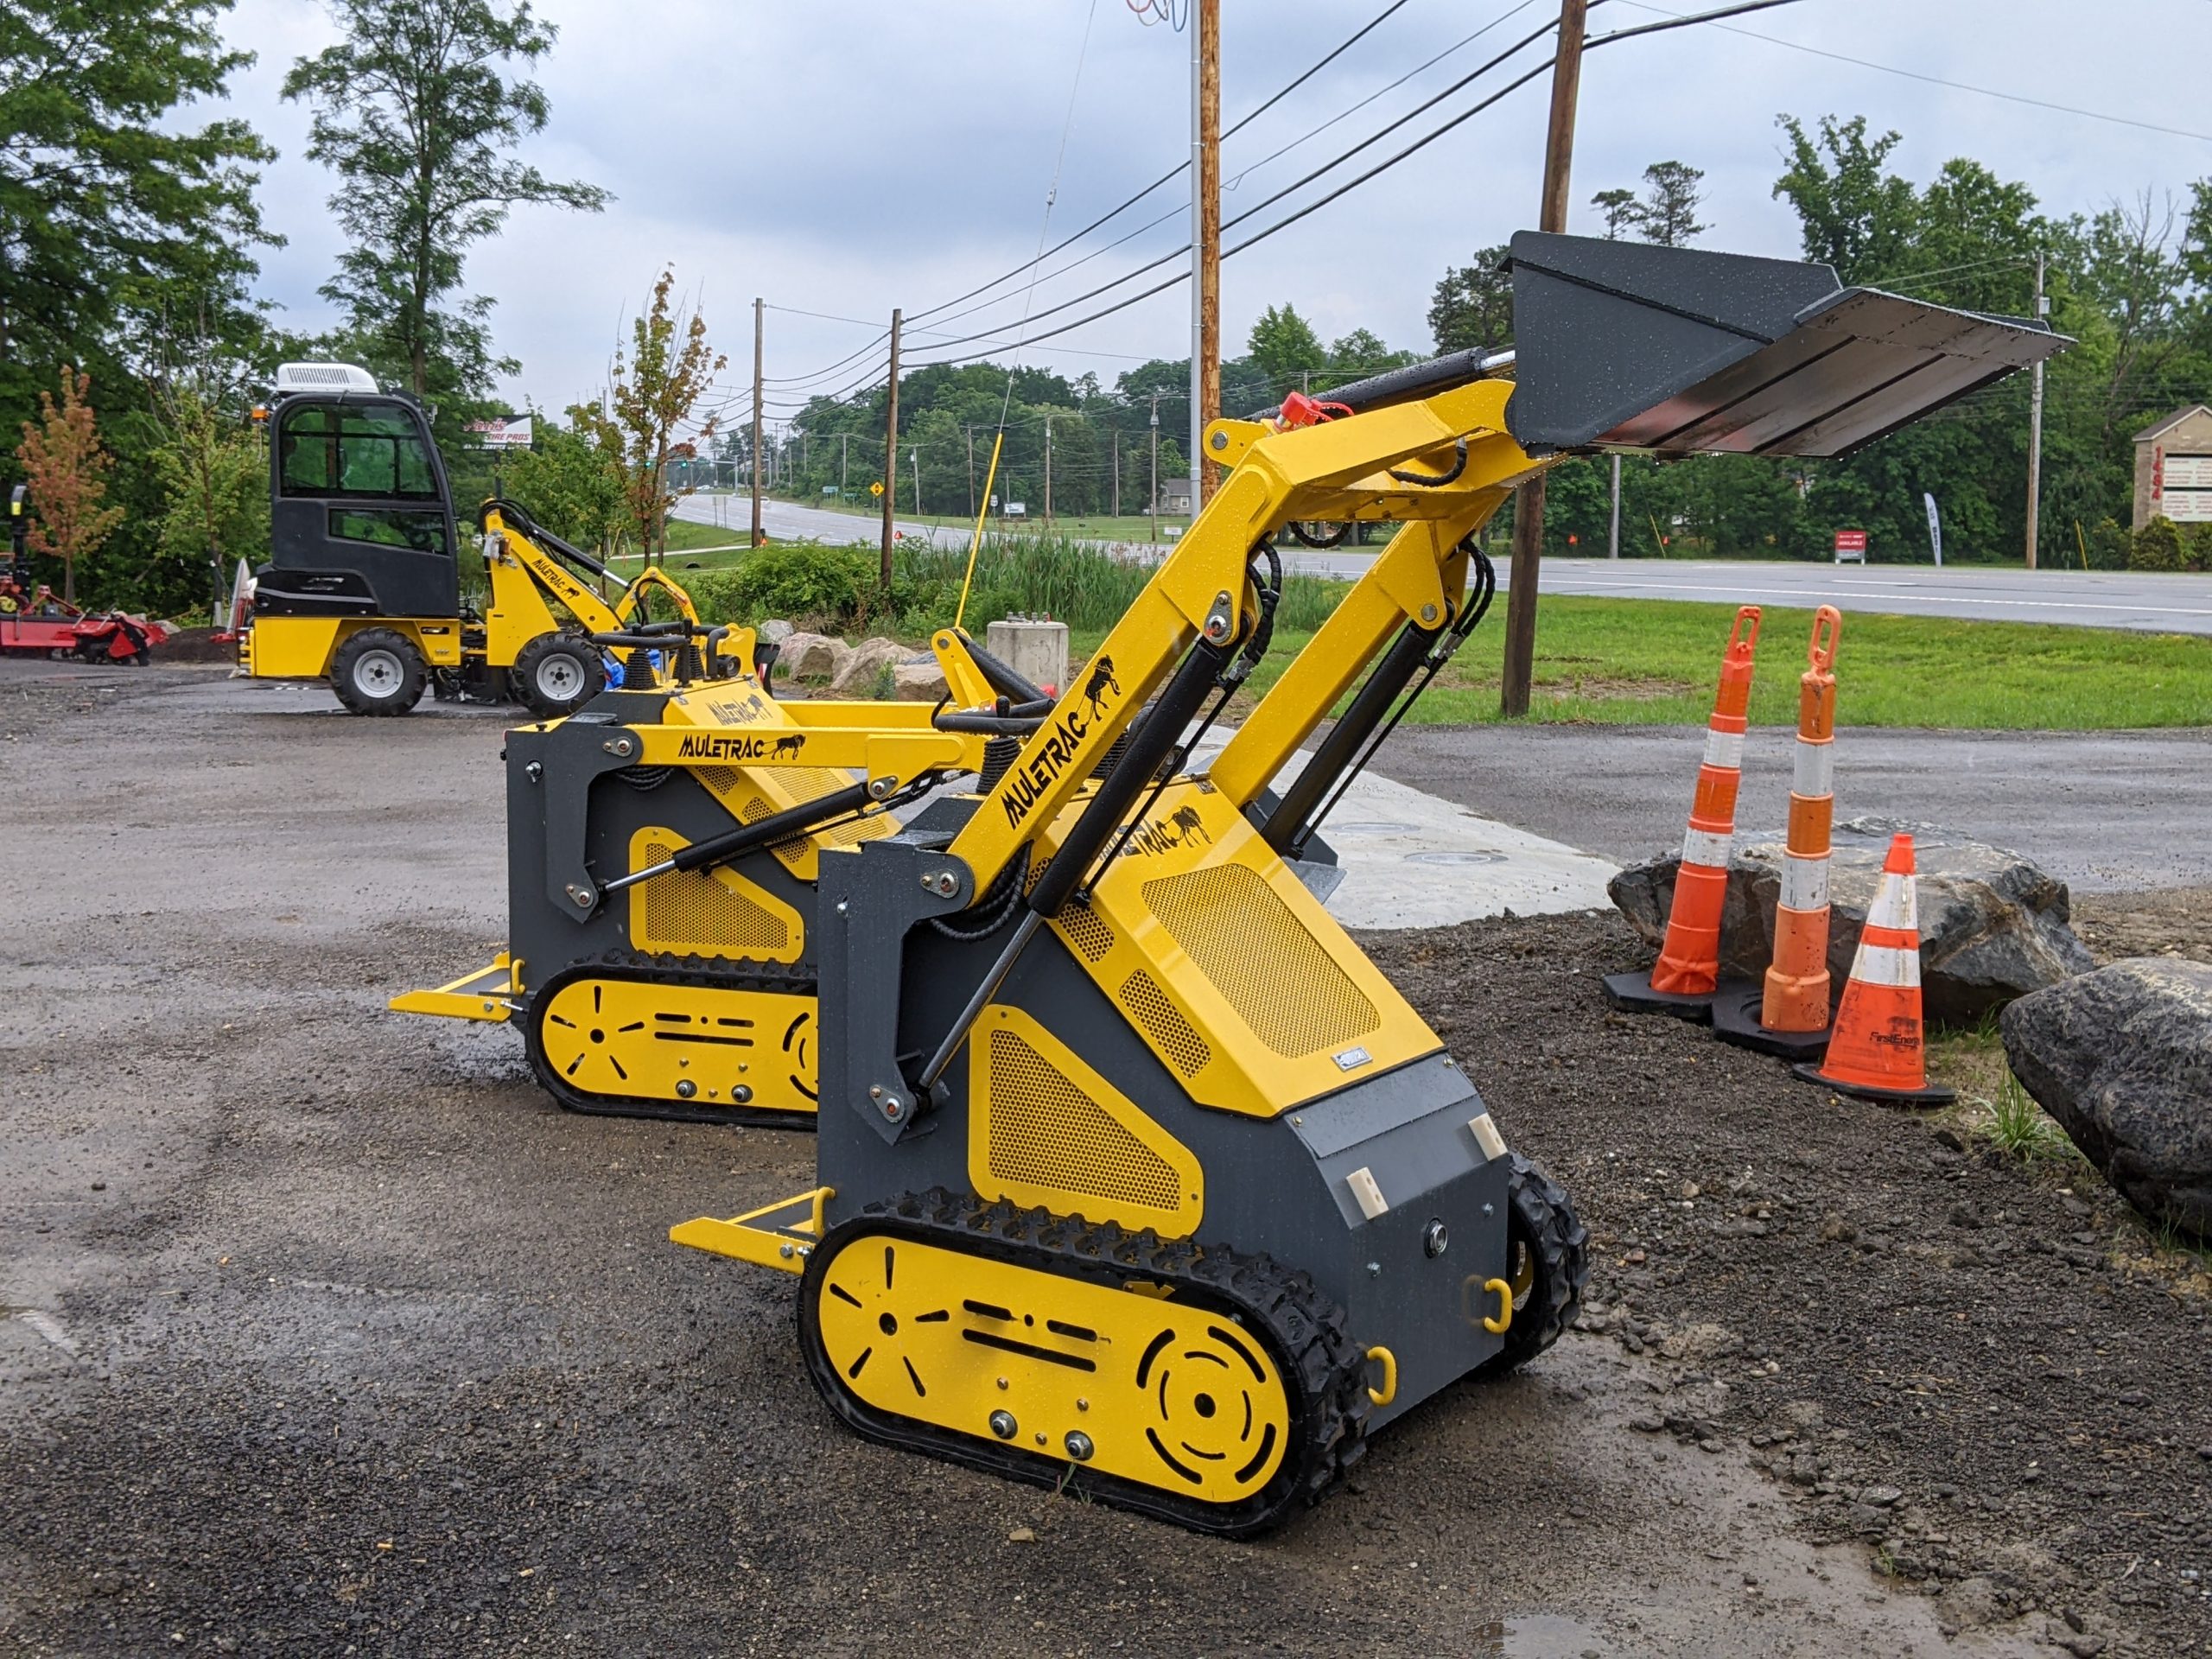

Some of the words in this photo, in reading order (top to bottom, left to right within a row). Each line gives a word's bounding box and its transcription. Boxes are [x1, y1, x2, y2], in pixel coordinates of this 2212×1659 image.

[531, 558, 566, 588] MULETRAC
[678, 734, 764, 760] MULETRAC
[1000, 712, 1086, 830] MULETRAC
